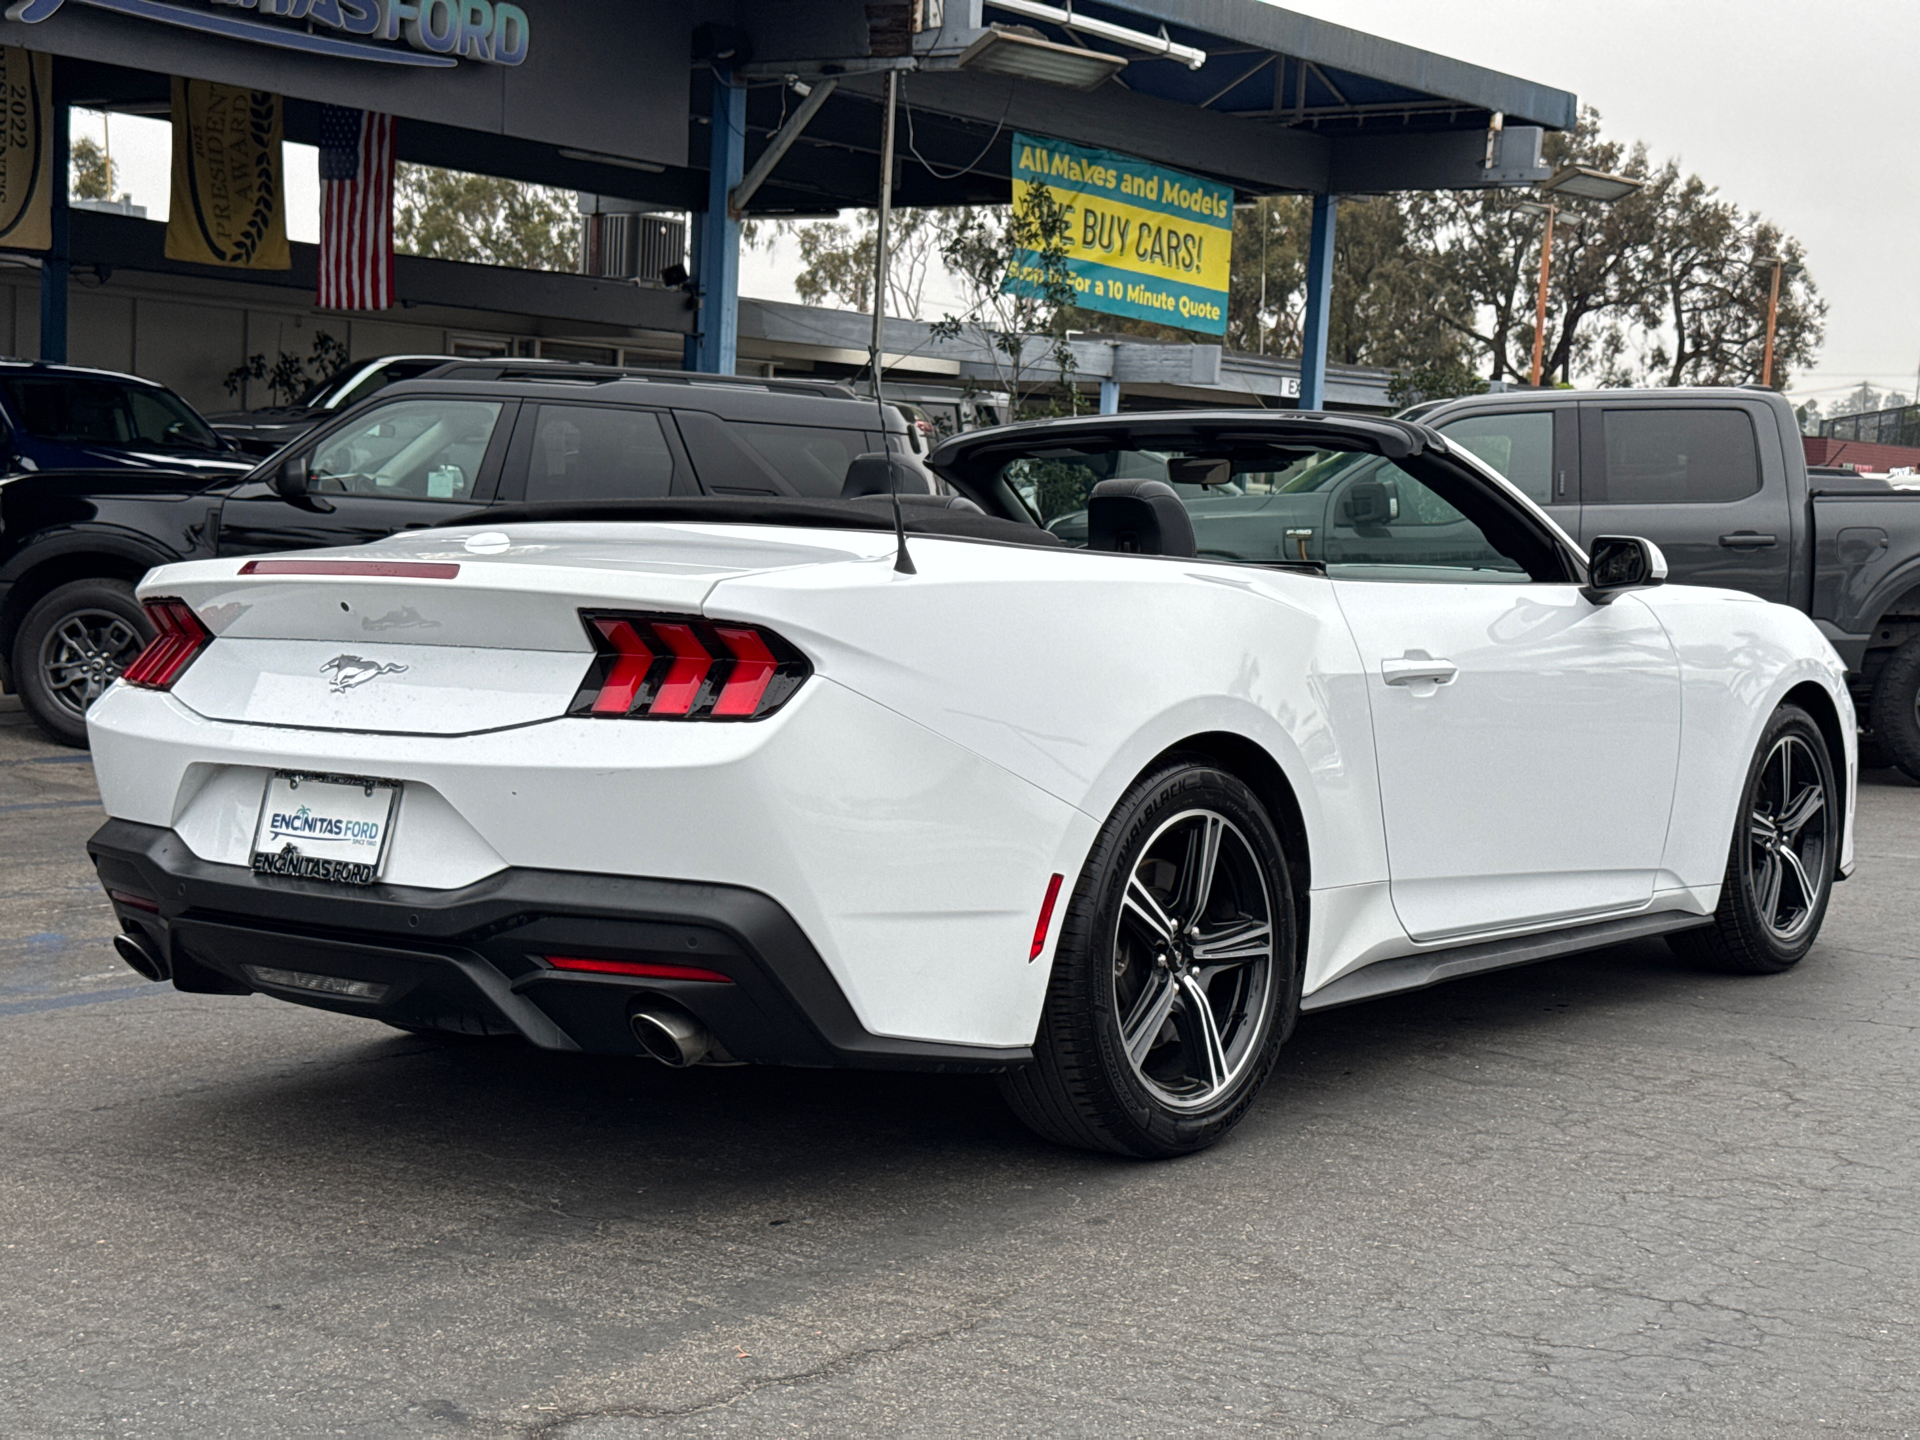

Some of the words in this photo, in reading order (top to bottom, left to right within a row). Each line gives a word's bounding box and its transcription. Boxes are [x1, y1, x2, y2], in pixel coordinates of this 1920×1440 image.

[383, 0, 530, 66] FORD
[10, 84, 27, 149] 2022
[230, 93, 254, 204] AWARD
[1019, 146, 1048, 174] All
[1052, 153, 1117, 190] Makes
[1120, 172, 1158, 202] and
[1162, 180, 1228, 219] Models
[1082, 207, 1131, 255] BUY
[1136, 222, 1204, 274] CARS!
[1095, 282, 1104, 296] a
[1108, 280, 1123, 300] 10
[1127, 283, 1176, 311] Minute
[1179, 295, 1221, 321] Quote
[270, 813, 343, 835] ENCINITAS
[344, 820, 378, 839] FORD
[252, 852, 332, 879] ENCINITAS
[333, 863, 372, 884] FORD
